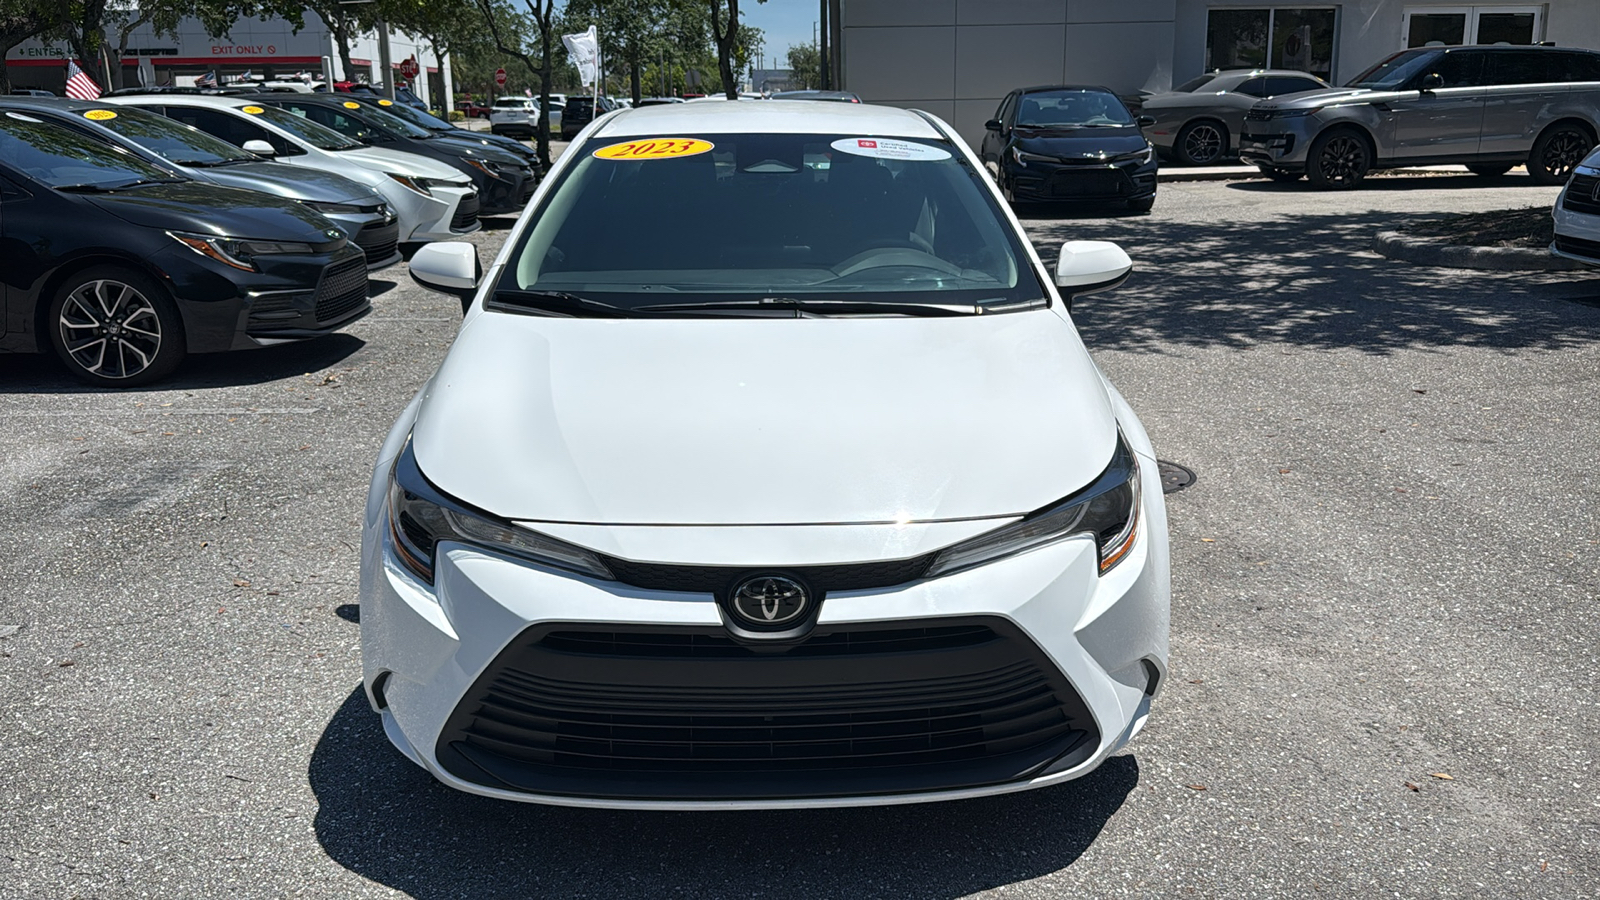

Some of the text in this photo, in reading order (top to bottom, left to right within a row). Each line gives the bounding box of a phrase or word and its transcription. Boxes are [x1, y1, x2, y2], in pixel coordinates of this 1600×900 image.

[29, 47, 63, 57] ENTER
[212, 45, 263, 54] EXIT ONLY
[610, 141, 695, 157] 2023
